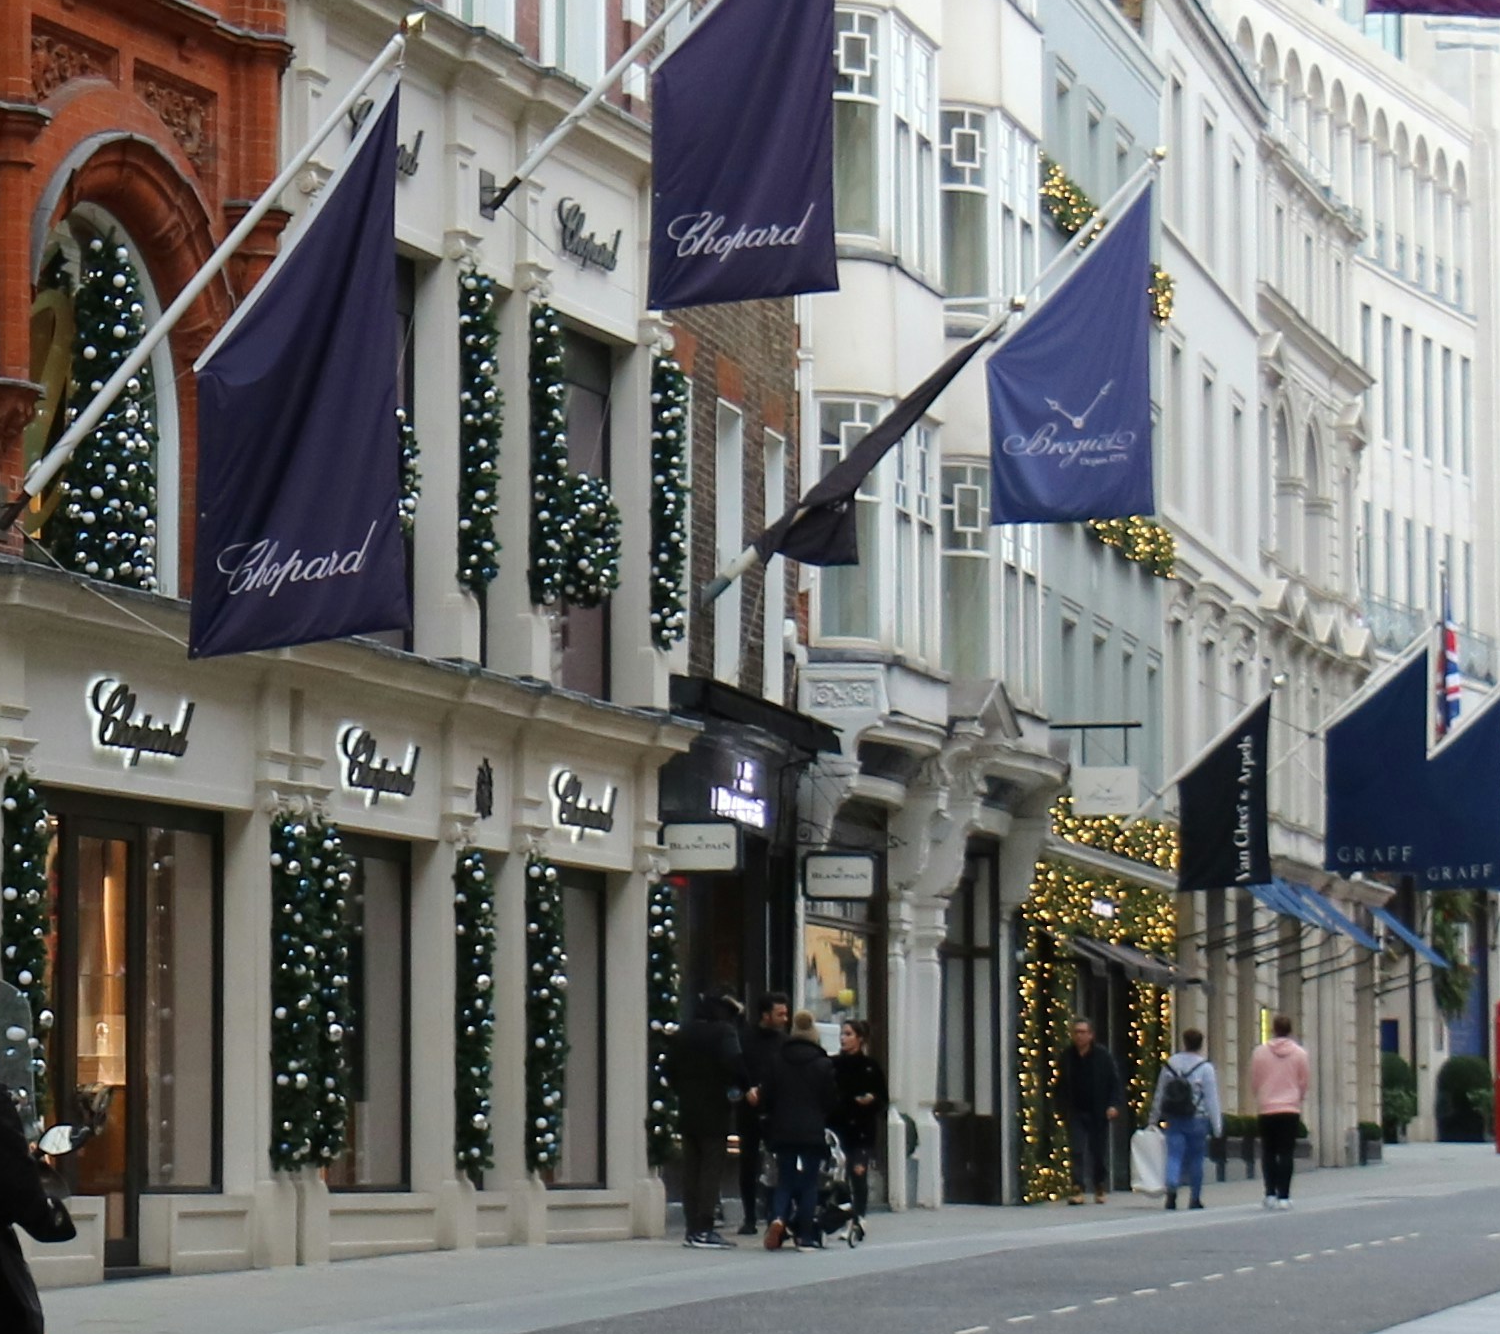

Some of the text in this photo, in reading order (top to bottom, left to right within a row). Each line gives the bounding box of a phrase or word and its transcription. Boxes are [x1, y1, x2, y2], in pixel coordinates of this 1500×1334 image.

[667, 202, 815, 262] Chopard
[1002, 423, 1136, 469] Breguet
[216, 520, 378, 598] Chopard
[1336, 845, 1413, 864] GRAFF
[1427, 863, 1494, 882] GRAFF
